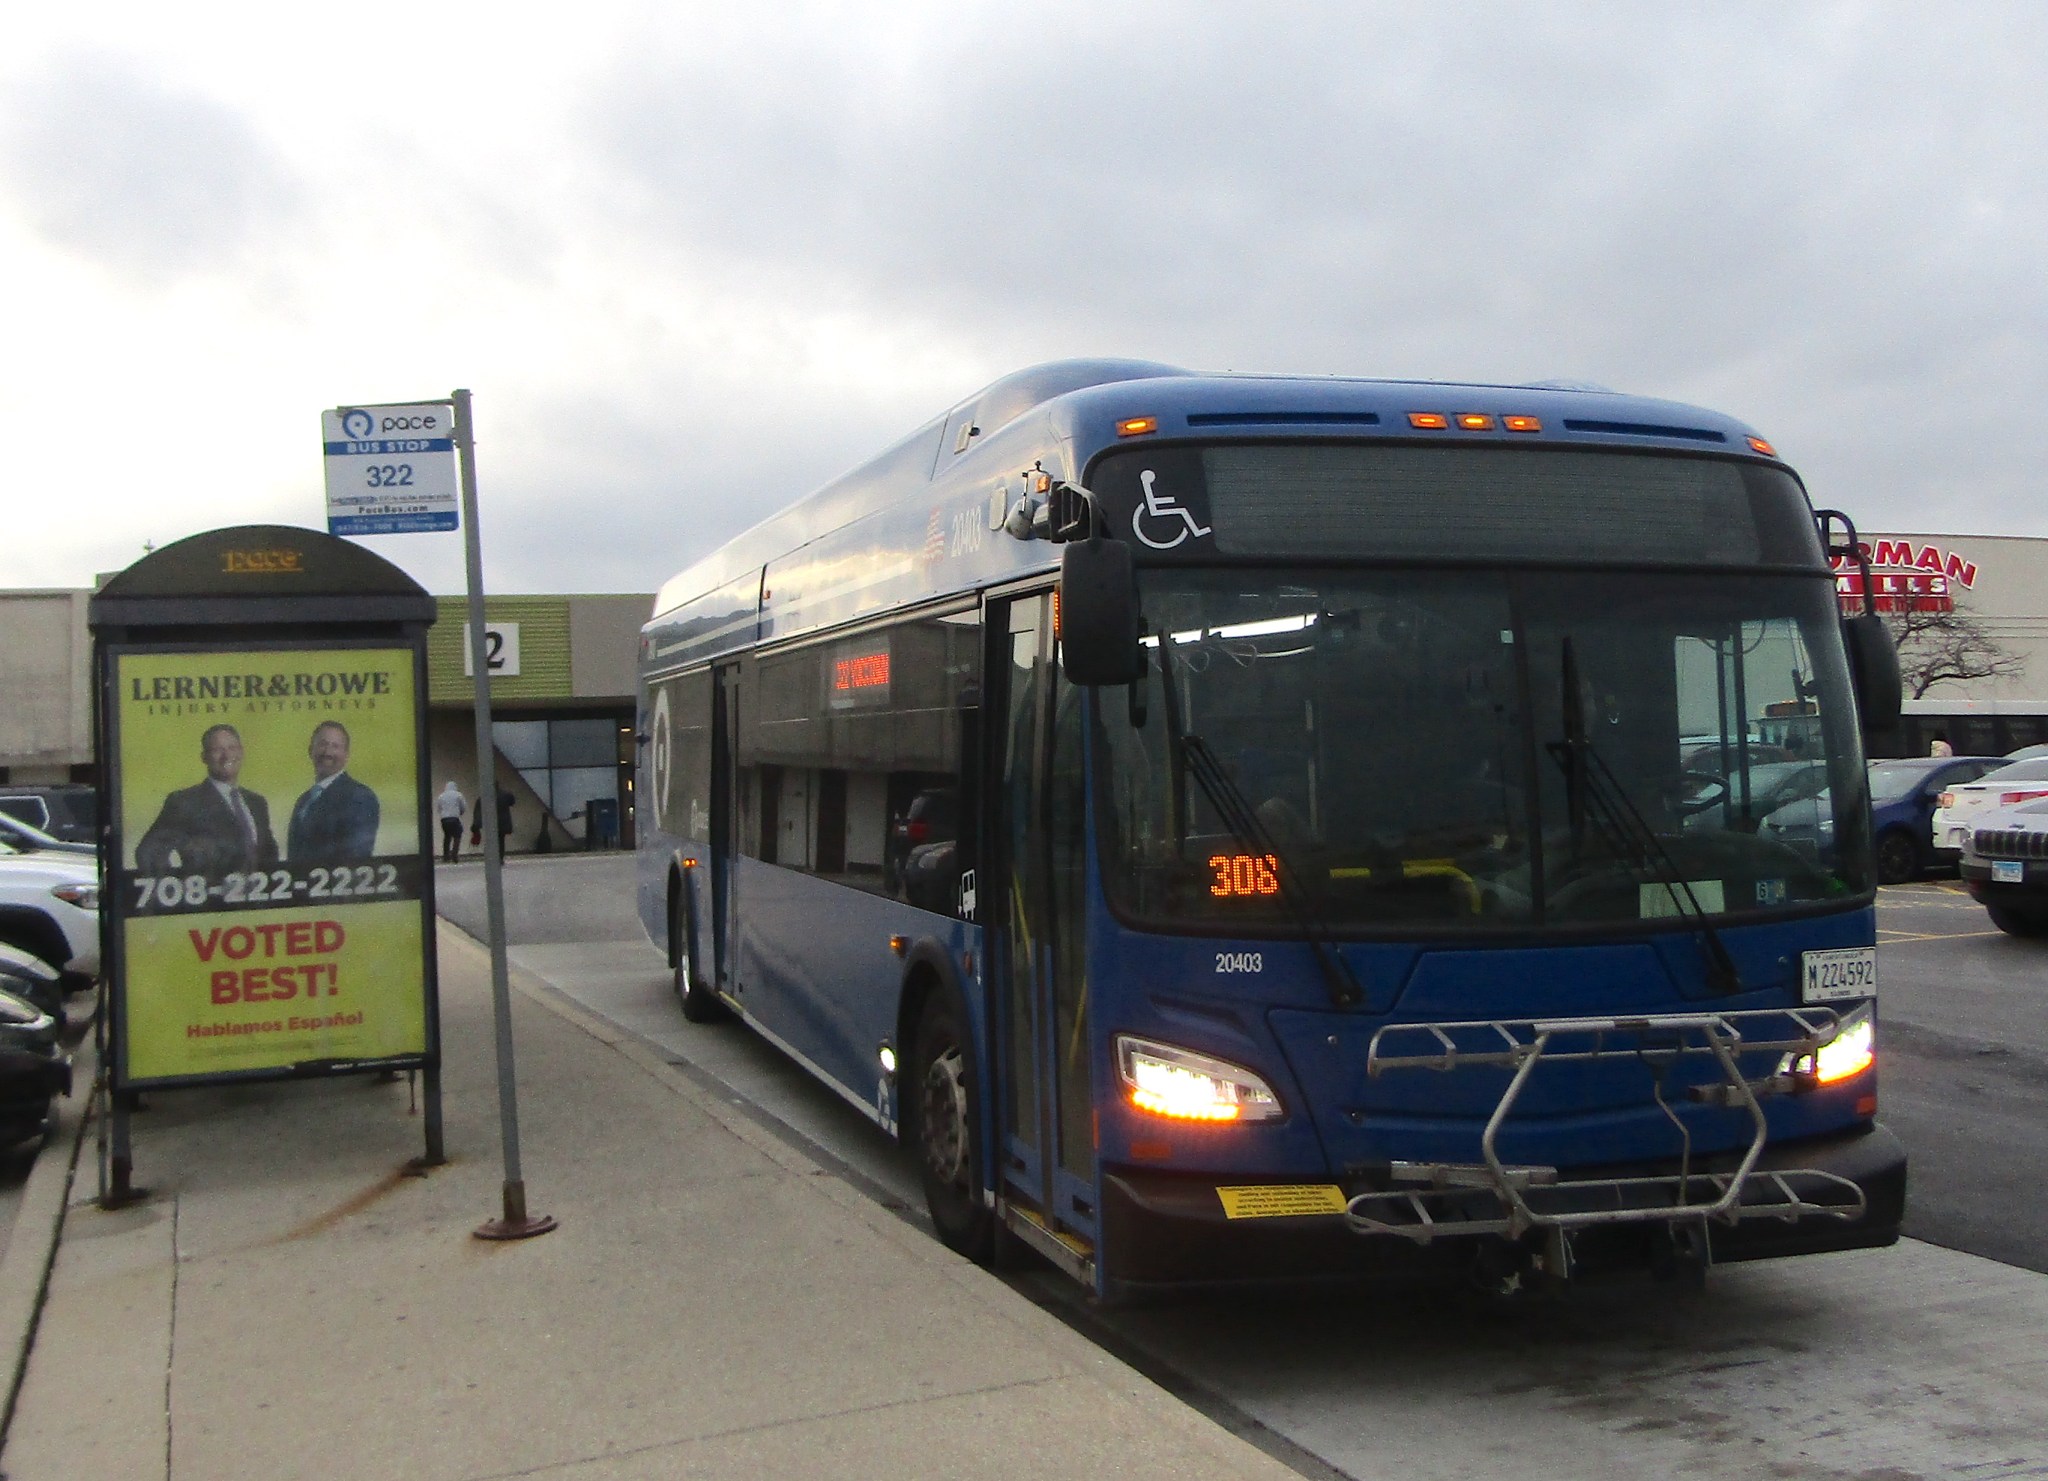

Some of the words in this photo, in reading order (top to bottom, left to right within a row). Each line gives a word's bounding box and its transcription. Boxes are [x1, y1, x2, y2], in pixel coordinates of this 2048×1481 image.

[382, 415, 437, 433] pace
[346, 441, 381, 454] BUS
[386, 440, 431, 452] STOP
[366, 464, 414, 487] 322
[358, 504, 429, 515] PaceBus.com
[485, 630, 506, 669] 2
[148, 702, 230, 717] INJURY
[245, 697, 377, 714] ATTORNEYS
[133, 863, 399, 909] 708-222-2222
[1208, 853, 1279, 897] 308
[188, 919, 347, 962] VOTED
[1215, 952, 1263, 973] 20403
[1821, 960, 1873, 988] 224592
[210, 963, 340, 1005] BEST!
[187, 1020, 283, 1039] Hablamos
[288, 1010, 364, 1032] Español
